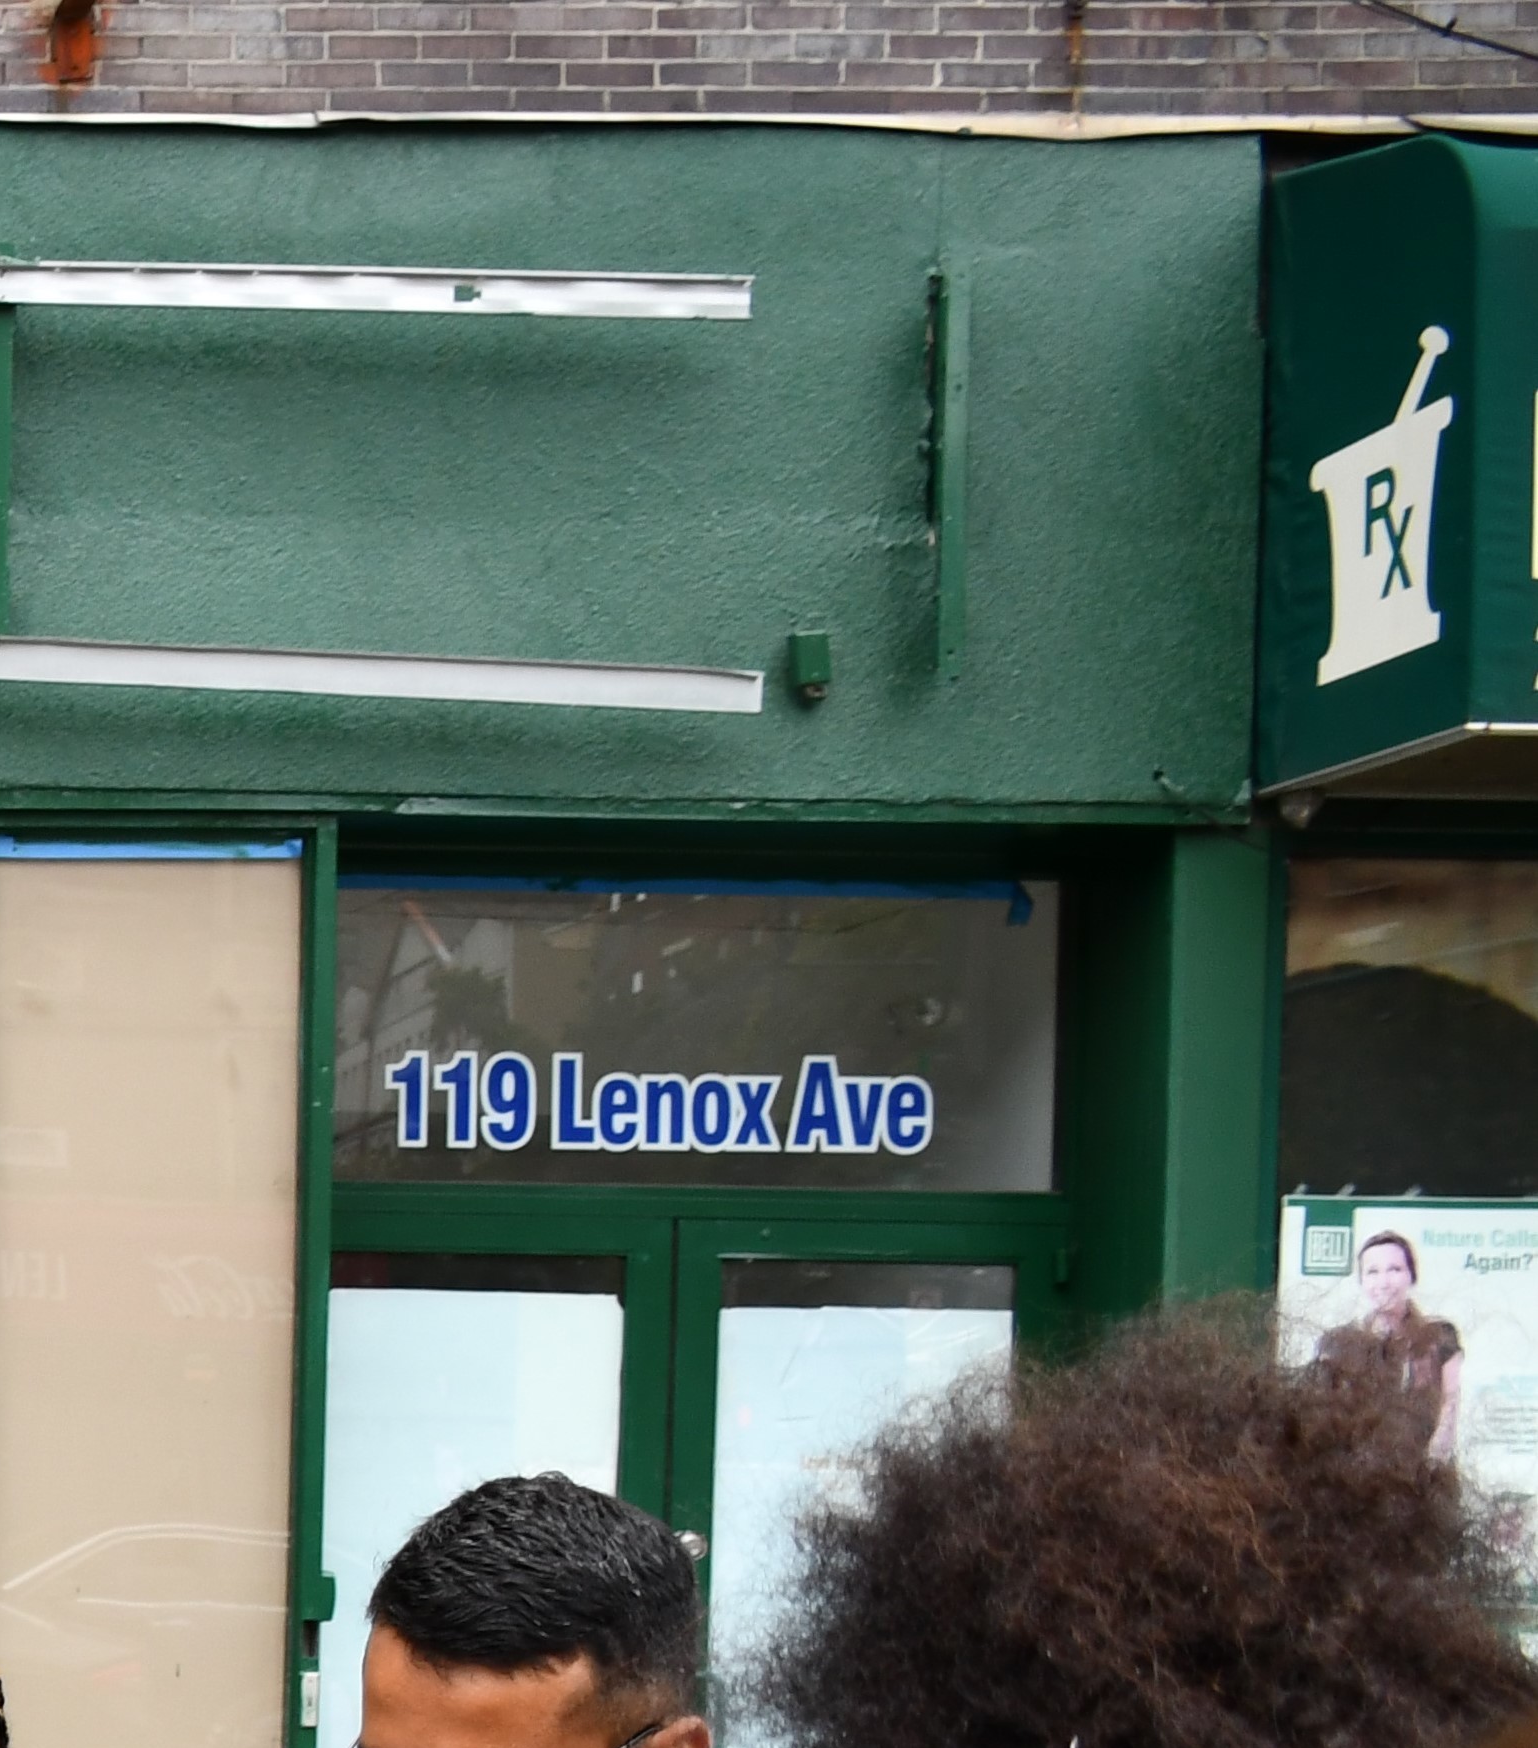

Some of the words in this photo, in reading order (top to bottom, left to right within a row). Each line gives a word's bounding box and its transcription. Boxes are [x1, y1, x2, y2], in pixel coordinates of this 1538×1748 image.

[386, 1050, 537, 1152] 119
[551, 1051, 782, 1154] Lenox
[784, 1053, 934, 1156] Ave
[1422, 1229, 1485, 1247] Nature
